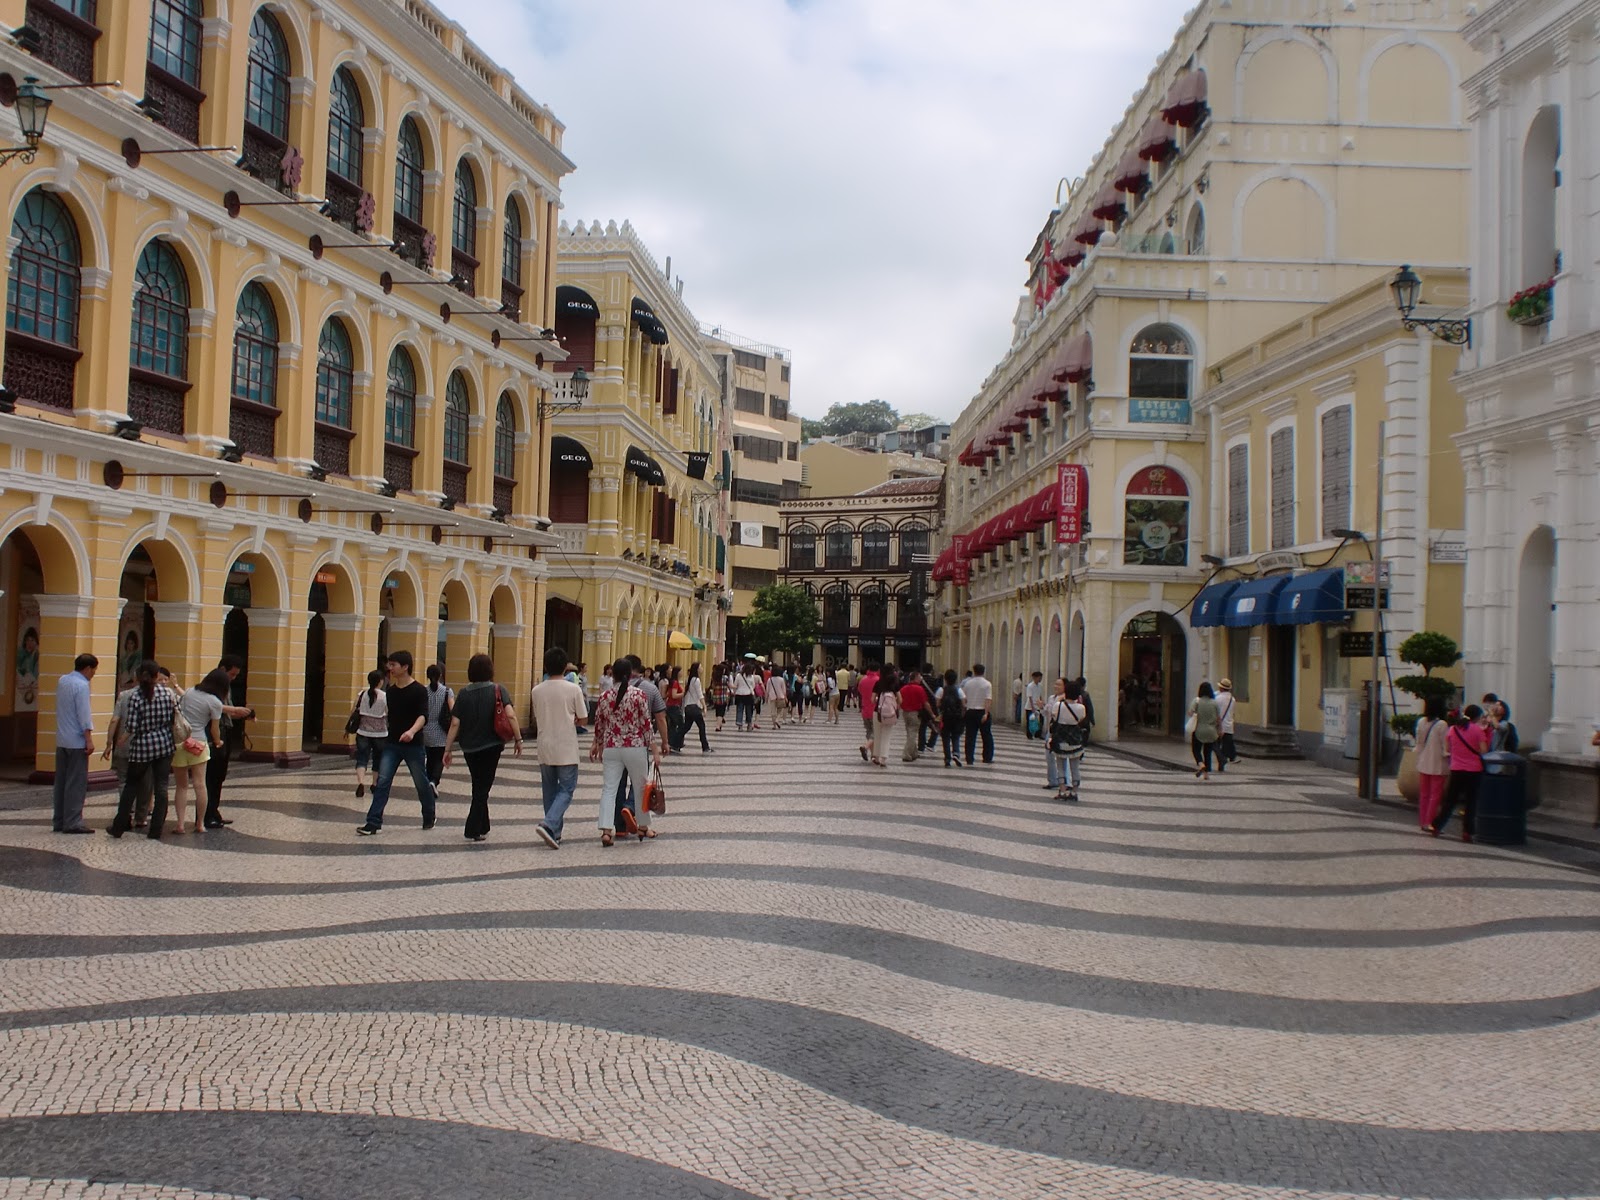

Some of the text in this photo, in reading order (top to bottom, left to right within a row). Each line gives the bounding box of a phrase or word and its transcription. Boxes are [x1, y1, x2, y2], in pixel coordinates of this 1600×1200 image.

[567, 300, 594, 310] GEOX
[634, 309, 654, 318] GEOX
[1138, 400, 1181, 409] ESTELA
[560, 454, 587, 462] GEOX
[630, 459, 649, 468] GEOX
[1065, 475, 1075, 503] 太白樓
[895, 639, 919, 647] bauhaus
